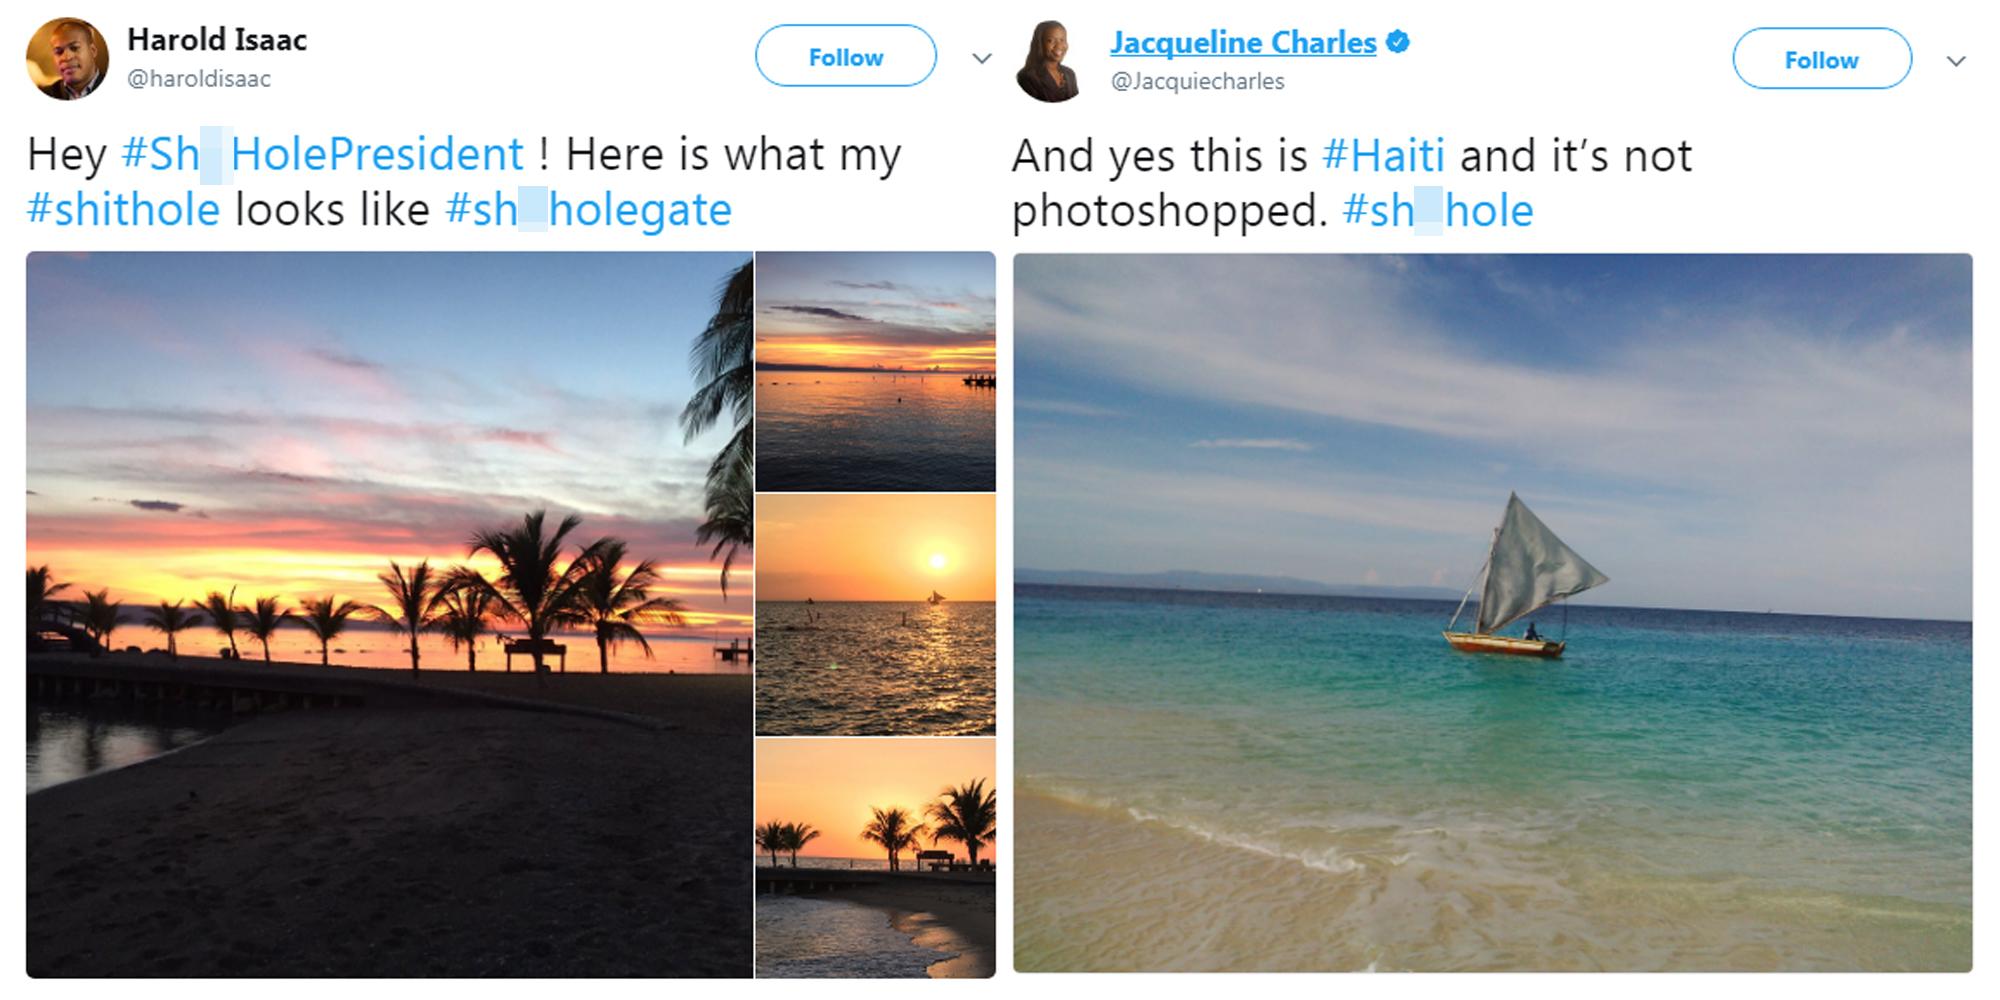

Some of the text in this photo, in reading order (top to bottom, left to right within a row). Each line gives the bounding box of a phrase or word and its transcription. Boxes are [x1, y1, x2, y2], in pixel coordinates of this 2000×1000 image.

[128, 26, 308, 51] Harold Isaac
[1110, 29, 1378, 60] Jacqueline Charles
[809, 47, 885, 67] Follow
[1785, 50, 1860, 70] Follow
[127, 68, 271, 90] @haroldisaac
[1111, 71, 1285, 95] @Jacquiecharles
[28, 134, 902, 182] Hey #ShHolePresident ! Here is what my
[1011, 136, 1093, 173] And
[1108, 146, 1175, 183] yes
[1189, 136, 1263, 173] this
[1279, 136, 1308, 173] is
[1321, 136, 1445, 173] #Haiti
[1461, 136, 1535, 173] and
[1625, 140, 1693, 173] not
[26, 189, 732, 237] #shithole looks like #shholegate
[1013, 191, 1534, 238] photoshopped. #shhole
